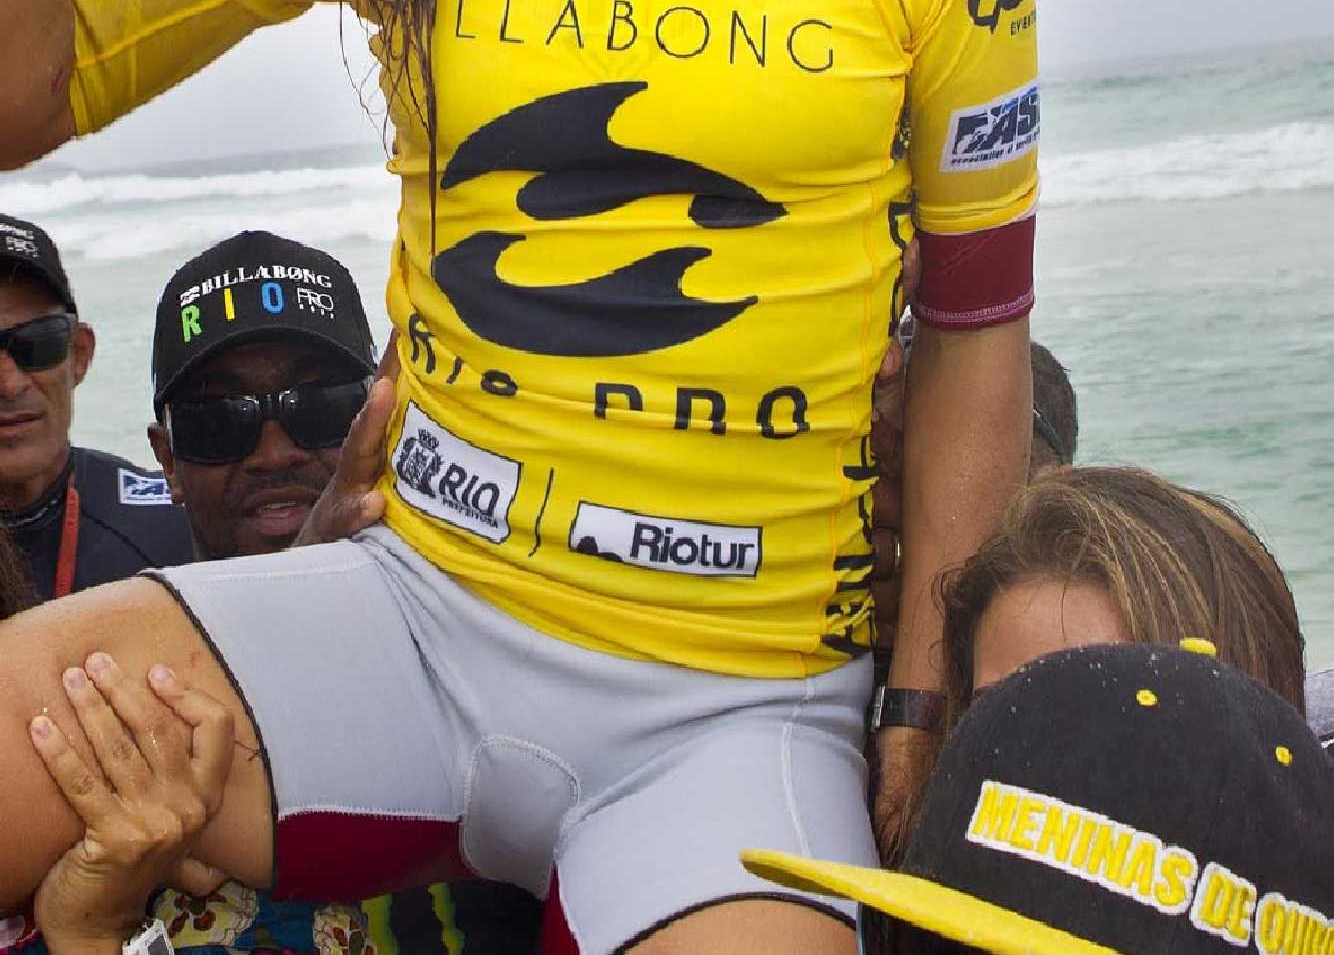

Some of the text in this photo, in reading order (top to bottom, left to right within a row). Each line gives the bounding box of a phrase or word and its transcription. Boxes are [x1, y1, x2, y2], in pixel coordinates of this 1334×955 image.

[202, 265, 332, 295] BILLABONG
[181, 281, 334, 342] RIO PRO
[439, 463, 500, 516] RIO
[630, 522, 755, 569] Riotur
[968, 783, 1198, 912] MENINAS
[1194, 865, 1256, 945] DE
